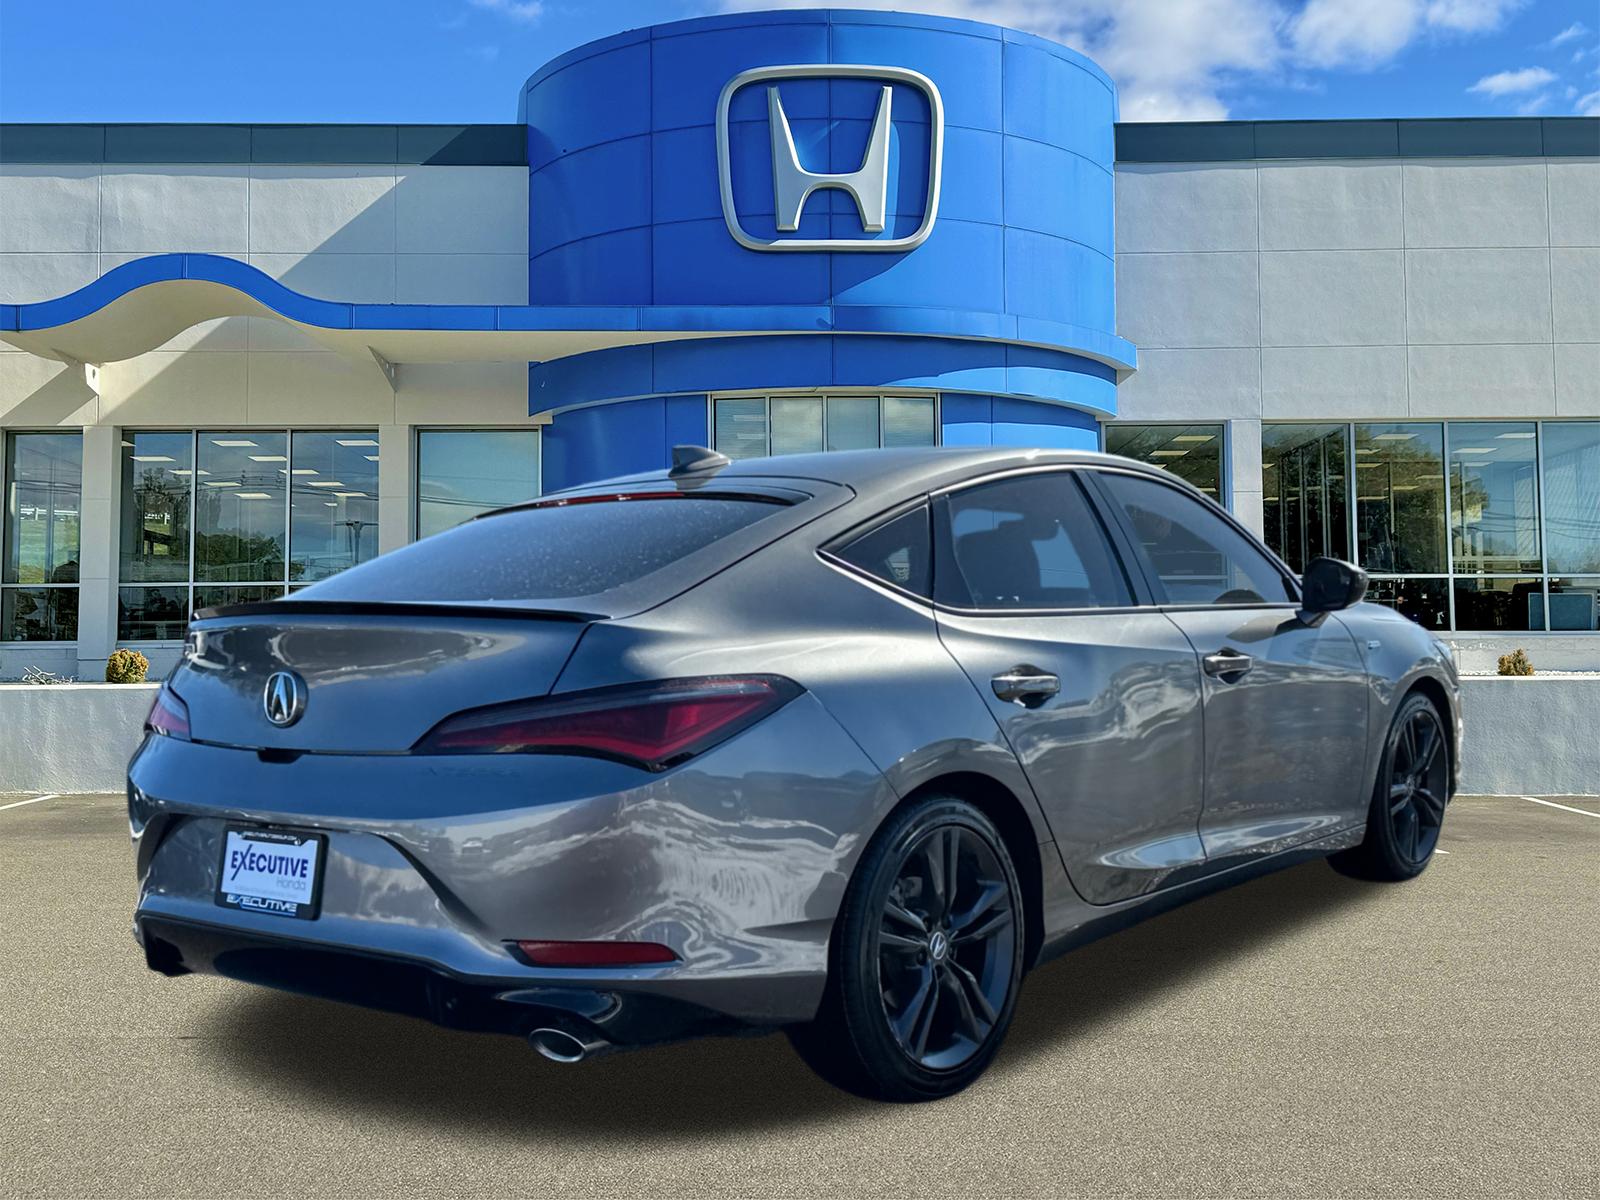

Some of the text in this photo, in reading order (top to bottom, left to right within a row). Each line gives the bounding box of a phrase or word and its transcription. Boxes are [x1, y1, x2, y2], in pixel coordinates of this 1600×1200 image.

[230, 844, 308, 881] EXECUTIVE
[276, 877, 306, 890] Honda
[226, 894, 298, 913] EXECUTIVE
